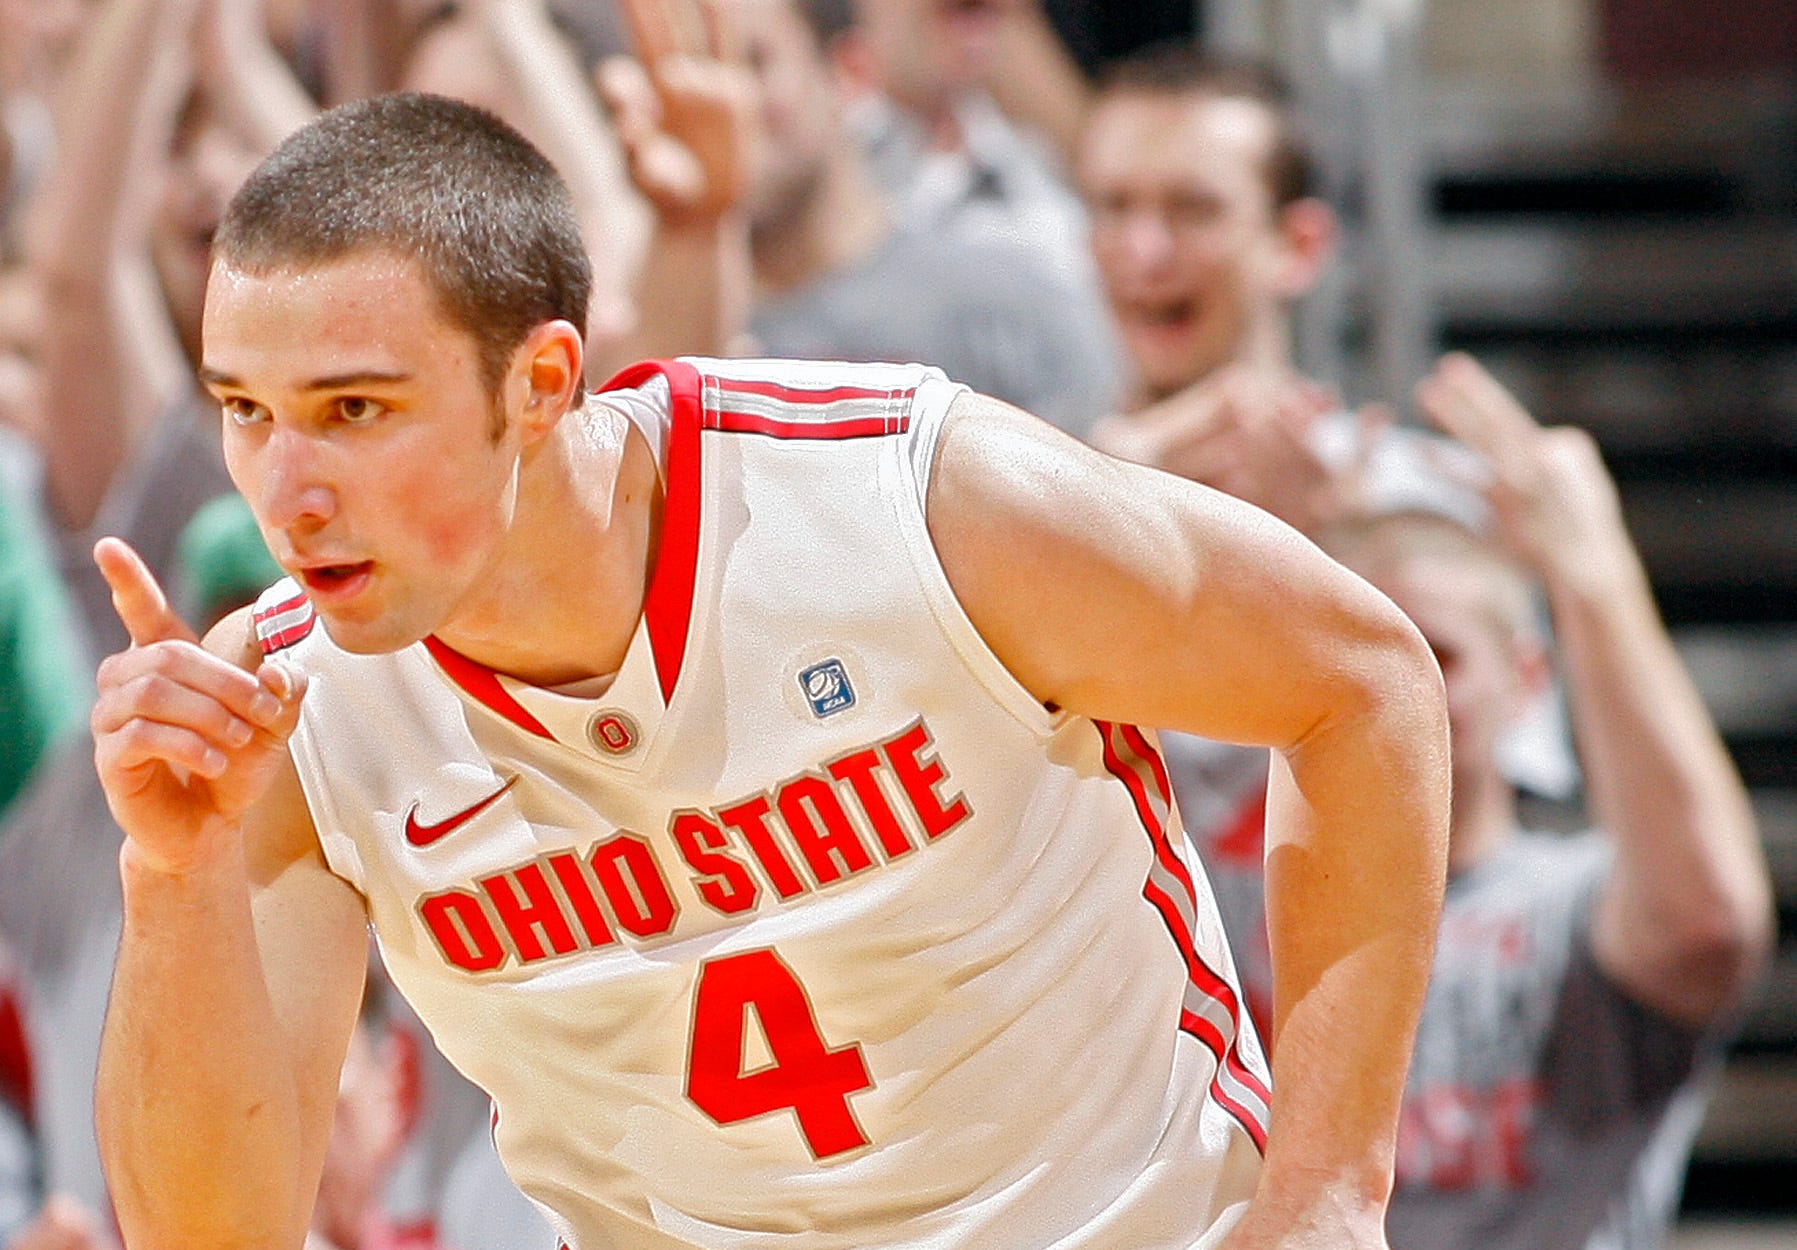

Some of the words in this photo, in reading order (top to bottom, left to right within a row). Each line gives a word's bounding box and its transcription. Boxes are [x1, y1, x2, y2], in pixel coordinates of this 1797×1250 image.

[415, 830, 681, 974] OHIO
[667, 714, 974, 917] STATE
[682, 945, 877, 1162] 4
